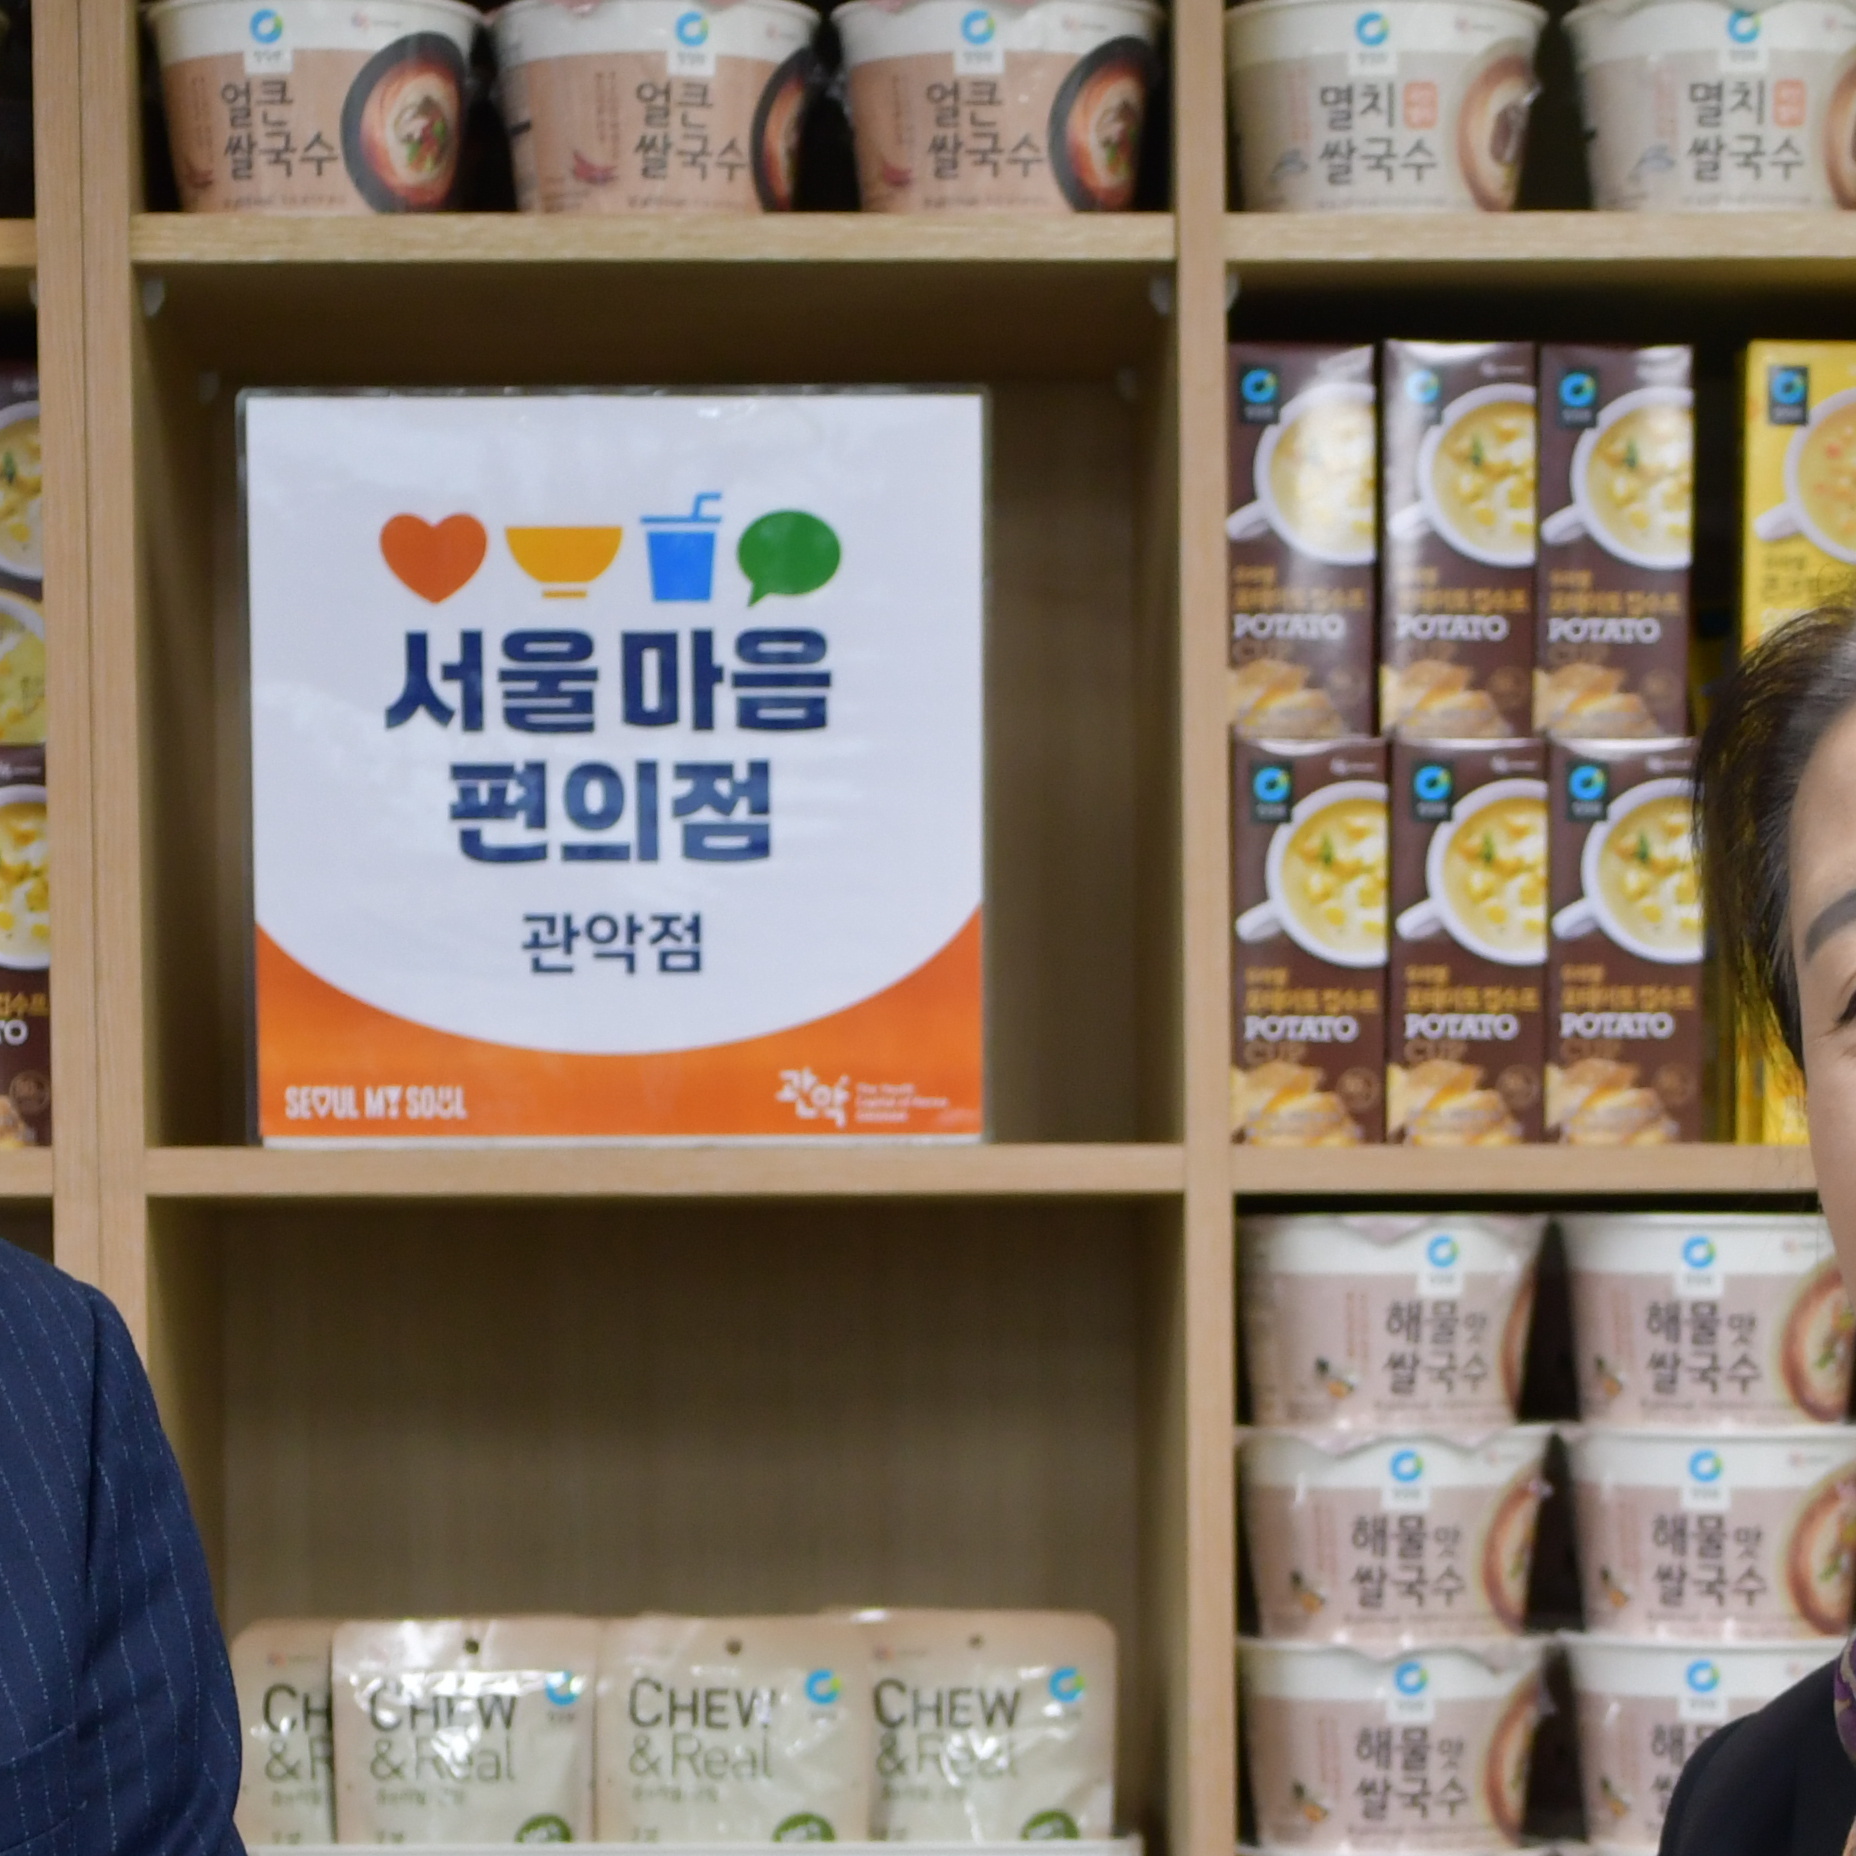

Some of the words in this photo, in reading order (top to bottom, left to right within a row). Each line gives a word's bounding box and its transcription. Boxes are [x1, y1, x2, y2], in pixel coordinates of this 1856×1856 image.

[220, 79, 294, 131] 얼큰
[634, 79, 711, 131] 얼큰
[924, 79, 1002, 131] 얼큰
[1319, 81, 1396, 133] 멸치
[1687, 80, 1766, 131] 멸치
[223, 130, 339, 181] 쌀국수
[634, 130, 746, 183] 쌀국수
[927, 130, 1046, 182] 쌀국수
[1318, 134, 1438, 187] 쌀국수
[1687, 133, 1805, 184] 쌀국수
[1233, 613, 1347, 642] POTATO
[1547, 617, 1662, 644] POTATO
[449, 758, 771, 865] 편의점
[520, 911, 704, 976] 관악점
[1244, 1014, 1359, 1042] POTATO
[1405, 1012, 1520, 1040] POTATO
[1559, 1011, 1675, 1039] POTATO
[1383, 1350, 1490, 1395] 쌀국수
[1645, 1350, 1763, 1395] 쌀국수
[1351, 1562, 1466, 1610] 쌀국수
[1651, 1562, 1768, 1610] 쌀국수
[628, 1677, 776, 1730] CHEW
[873, 1677, 1021, 1730] CHEW
[1354, 1774, 1470, 1821] 쌀국수
